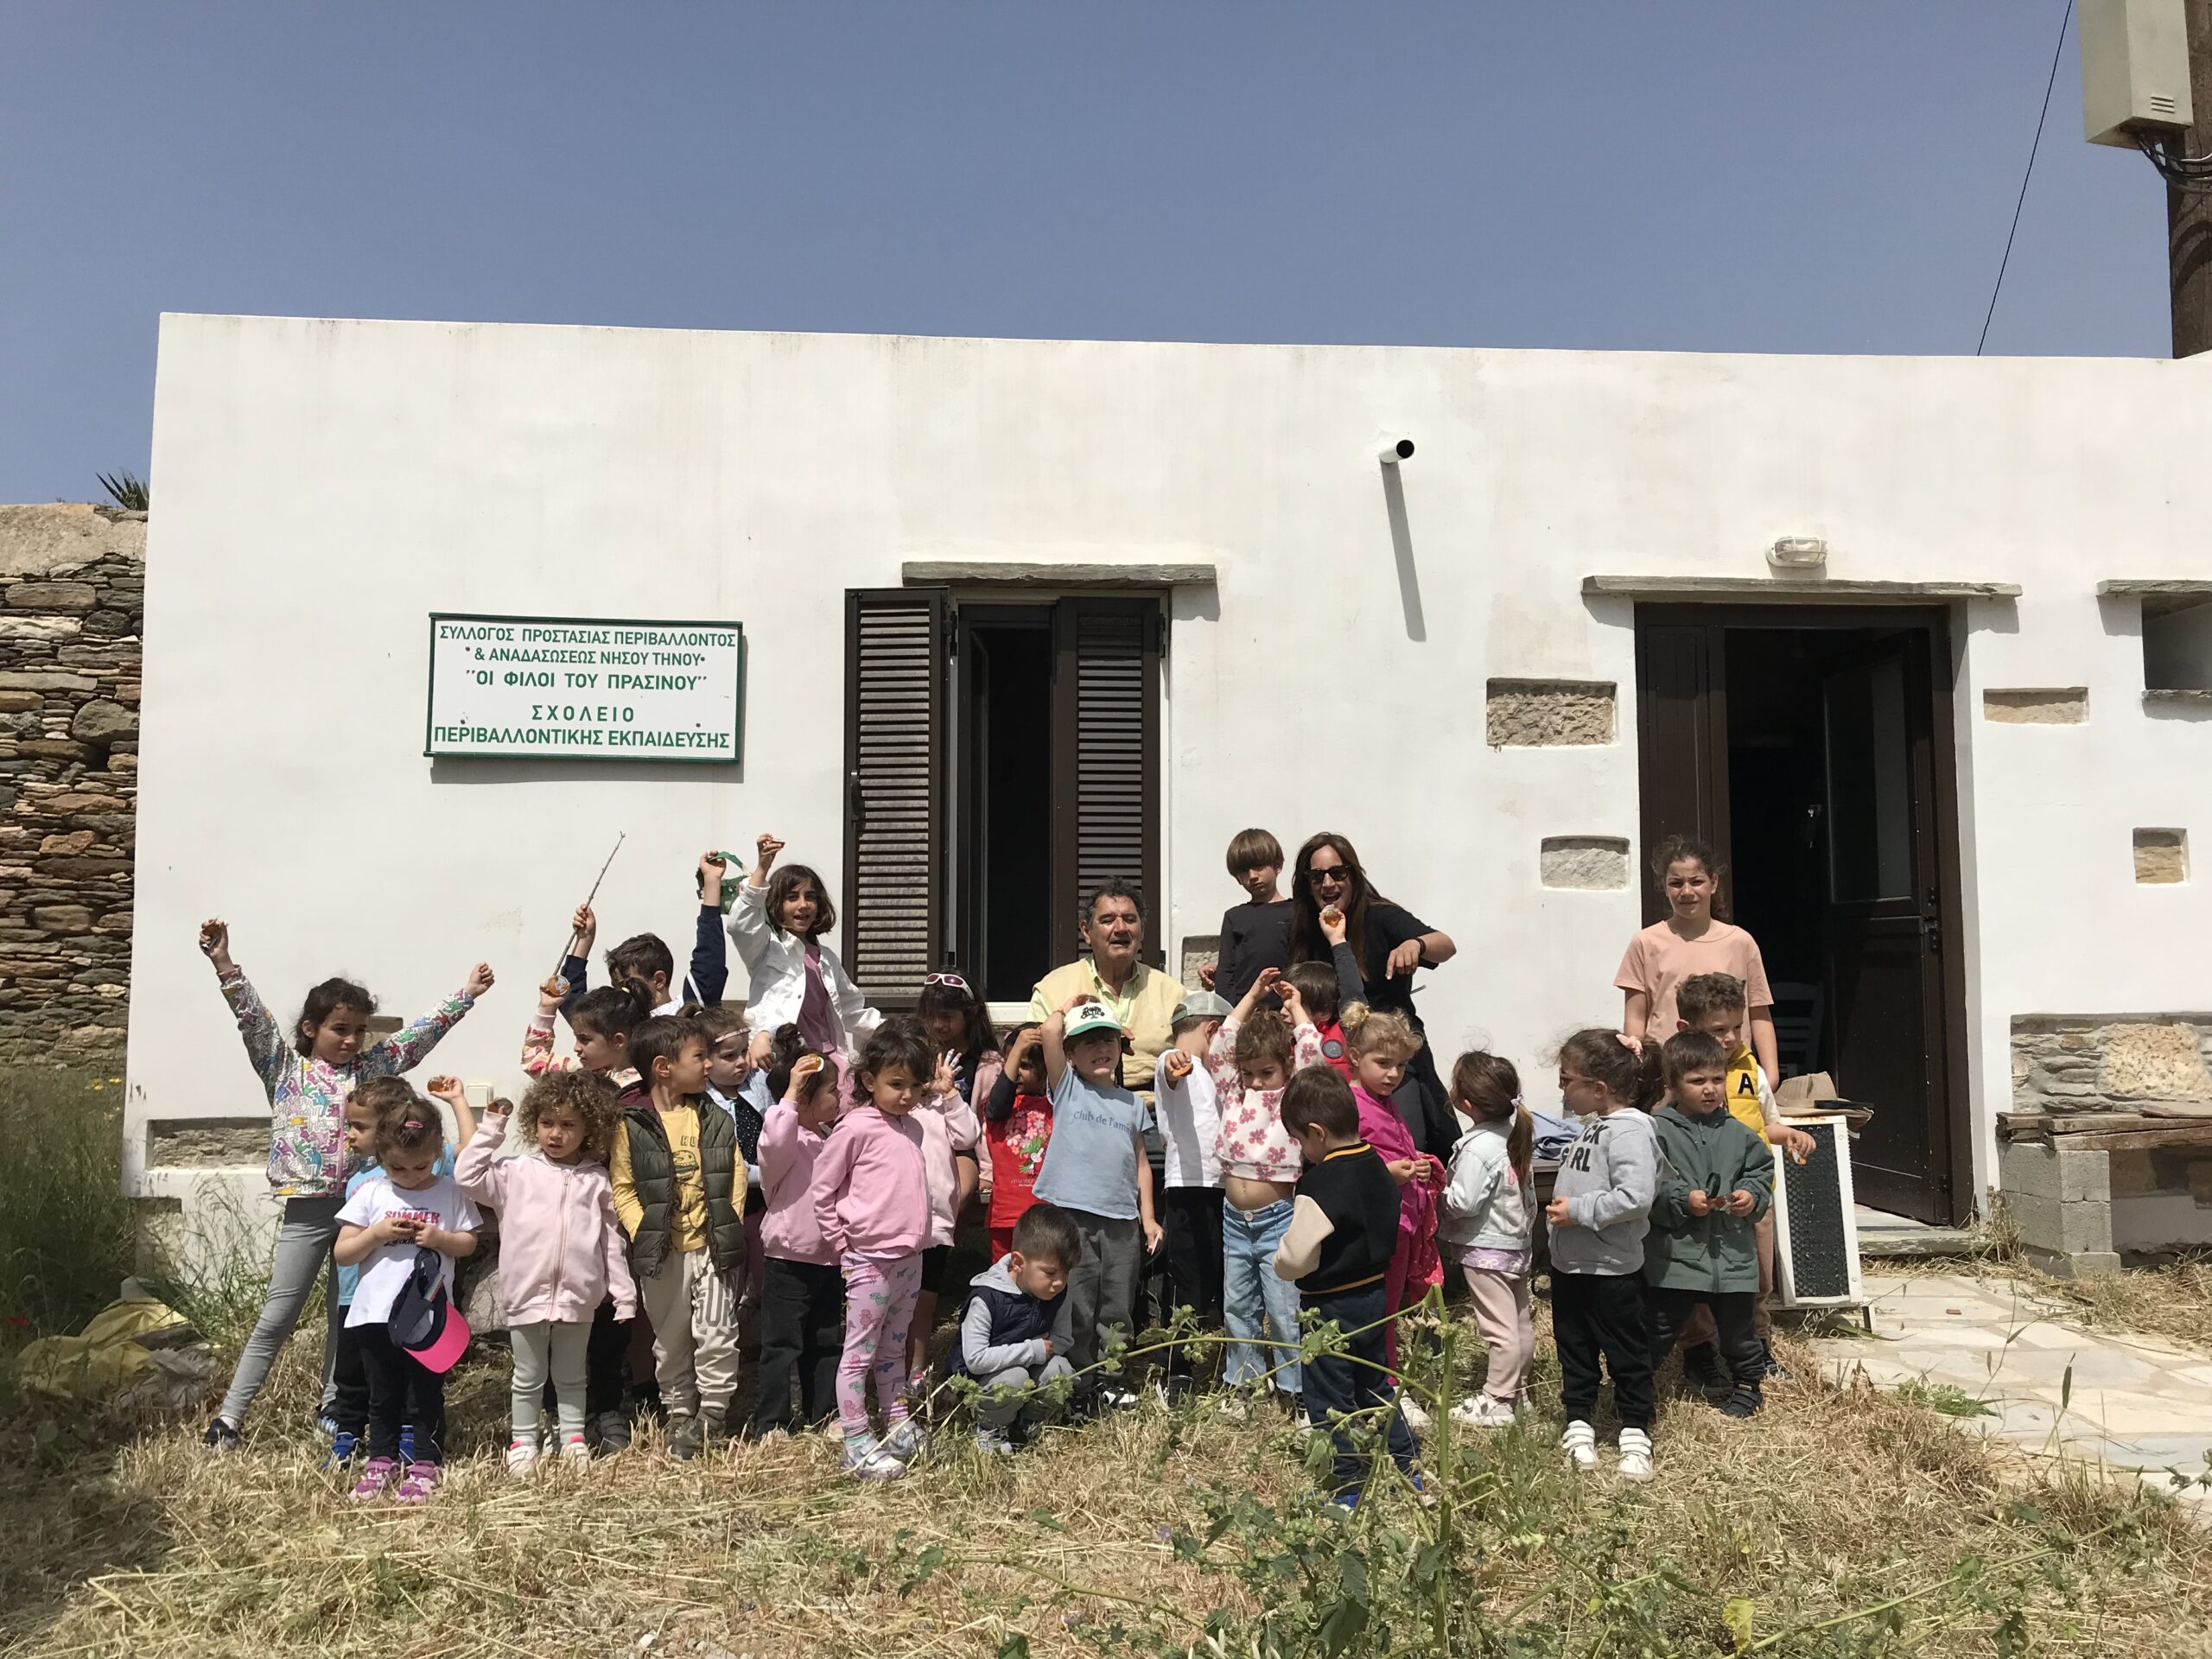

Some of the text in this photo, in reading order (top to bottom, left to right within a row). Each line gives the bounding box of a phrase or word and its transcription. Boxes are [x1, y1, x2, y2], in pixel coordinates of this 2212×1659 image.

[440, 626, 735, 647] ΣΥΛΛΟΓΟΣ ΠΡΟΣΤΑΣΙΑΣ ΠΕΡΙΒΑΛΛΟΝΤΟΣ
[474, 647, 701, 666] & ΑΝΑΔΑΣΩΣΕΩΣ ΝΗΣΟΥ ΤΗΝΟΥ
[504, 671, 555, 687] ΦΙΛΟΙ
[564, 673, 599, 688] ΤΟΥ
[531, 705, 634, 722] ΣΧΟΛΕΙΟ
[434, 727, 729, 748] ΠΕΡΙΒΑΛΛΟΝΤΙΚΗΣ ΕΚΠΑΙΔΕΥΣΗΣ
[1738, 1072, 1755, 1096] A
[1073, 1110, 1094, 1122] Club
[1096, 1115, 1107, 1125] de
